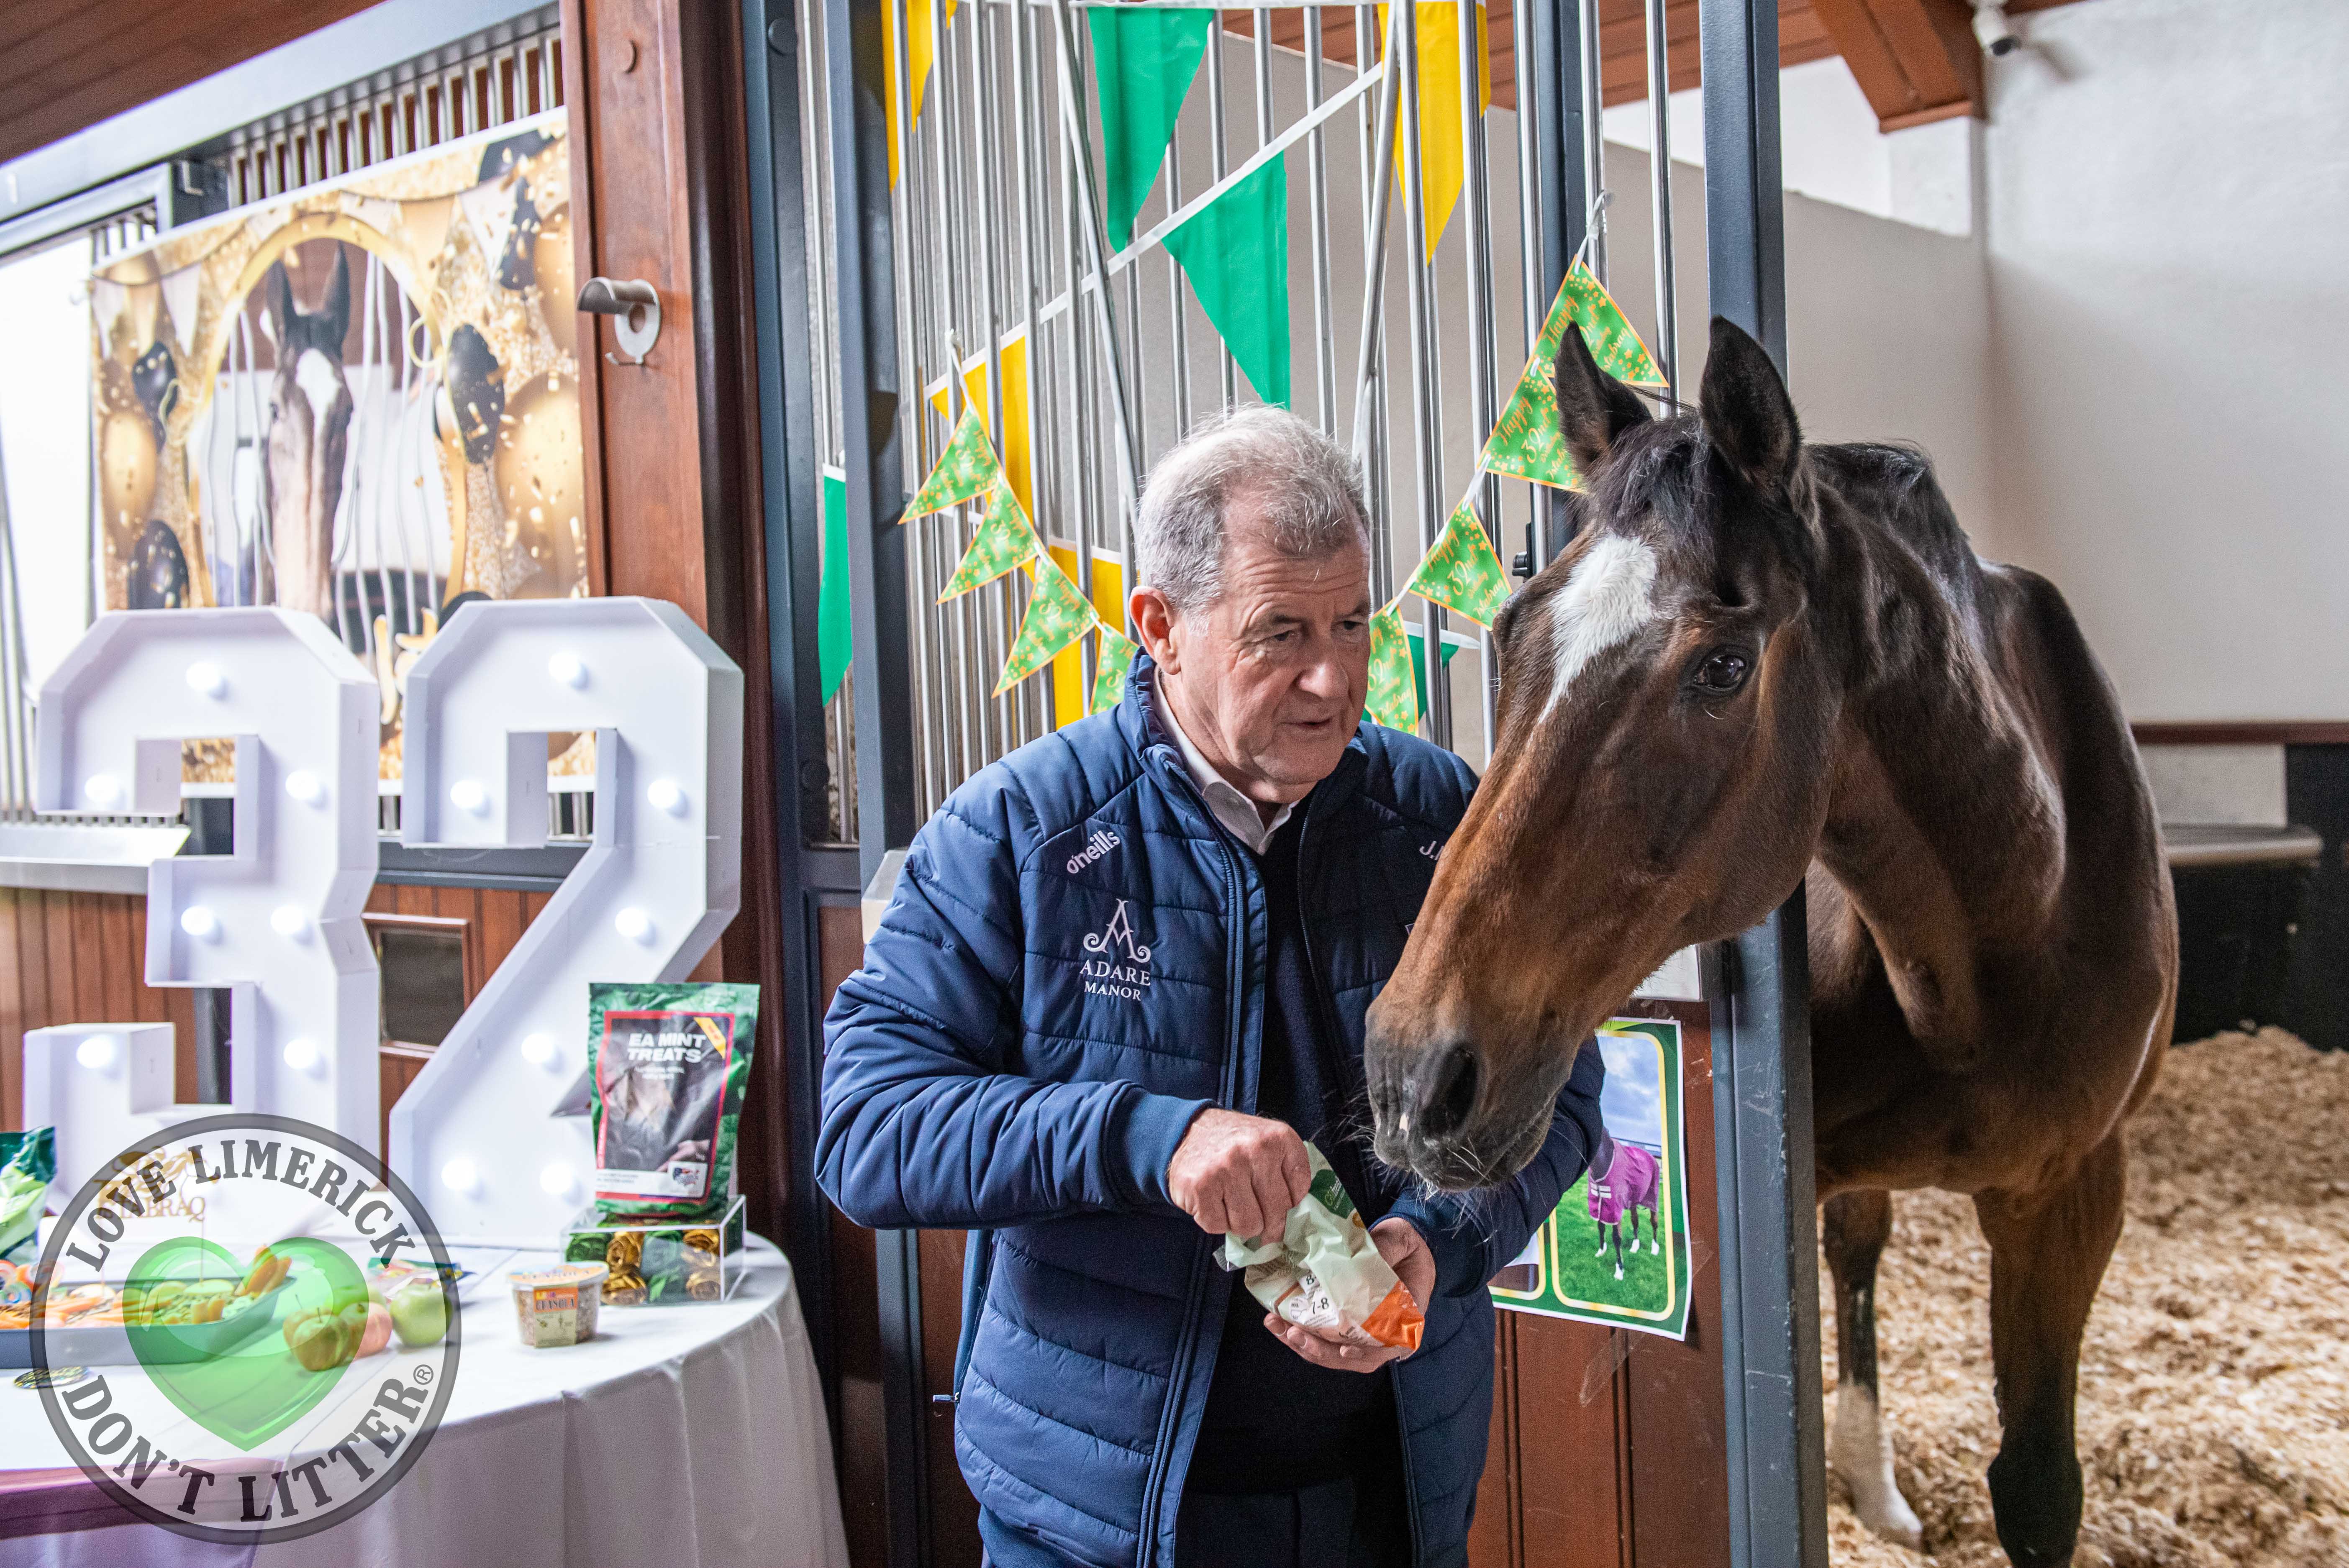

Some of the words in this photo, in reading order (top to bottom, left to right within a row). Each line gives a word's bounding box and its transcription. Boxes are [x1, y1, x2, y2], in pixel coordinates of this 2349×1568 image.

[1579, 304, 1599, 346] 2nd
[1493, 397, 1533, 446] Happy
[1521, 408, 1551, 463] 32nd
[1447, 544, 1478, 596] 32nd
[1080, 959, 1151, 986] ADARE
[1084, 981, 1141, 1001] MANOR
[627, 1047, 702, 1063] TREATS
[628, 1033, 654, 1047] EA
[658, 1032, 707, 1048] MINT
